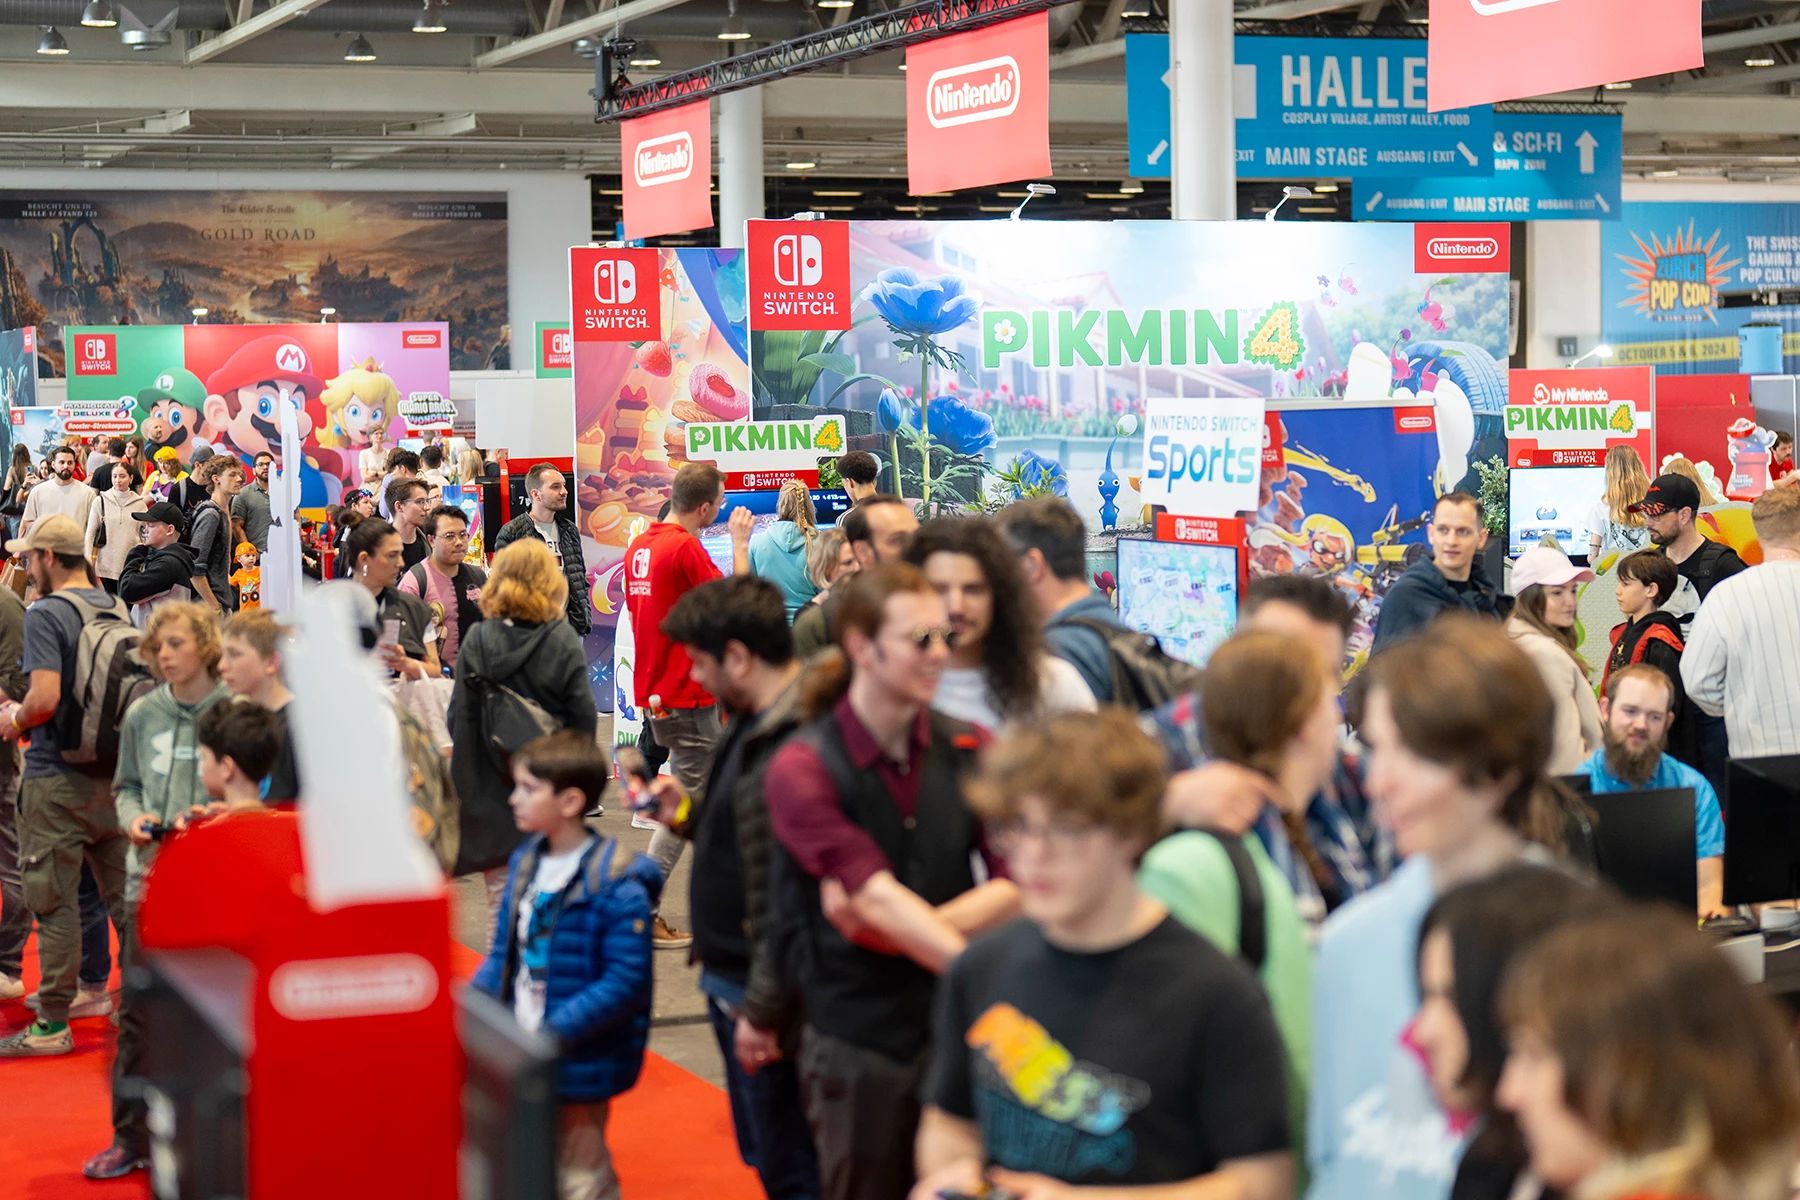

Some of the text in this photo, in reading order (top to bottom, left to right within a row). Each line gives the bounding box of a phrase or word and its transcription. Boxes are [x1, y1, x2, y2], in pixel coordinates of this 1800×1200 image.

[1282, 55, 1426, 109] HALLE
[934, 72, 1013, 114] Nintendo
[1282, 112, 1470, 126] COSPLAY VILLAGE, ARTIST ALLEY, FOOD
[1493, 131, 1562, 153] & SCI-FI
[640, 144, 688, 176] Nintendo
[1265, 147, 1310, 165] MAIN
[1315, 148, 1368, 166] STAGE
[1376, 151, 1425, 163] AUSGANG
[1432, 152, 1455, 164] EXIT
[222, 205, 236, 213] The
[1386, 199, 1424, 209] AUSGANG
[1453, 197, 1485, 211] MAIN
[1488, 197, 1530, 212] STAGE
[200, 228, 316, 243] GOLD ROAD
[1746, 236, 1767, 250] THE
[1433, 243, 1493, 254] Nintendo
[1748, 252, 1792, 267] GAMING
[1740, 267, 1762, 283] POP
[764, 292, 834, 300] NINTENDO
[1651, 280, 1710, 310] POP CON
[764, 302, 834, 315] SWITCH
[585, 317, 646, 329] SWITCH
[982, 303, 1302, 369] PIKMIN 4
[1618, 348, 1665, 361] OCTOBER
[1702, 343, 1727, 356] 2024
[1551, 387, 1608, 404] My Nintendo
[402, 402, 428, 414] MARIO
[408, 414, 450, 425] WONDER
[1150, 415, 1258, 432] NINTENDO SWITCH
[1507, 404, 1634, 433] PIKMIN 4
[689, 420, 843, 453] PIKMIN 4
[1148, 435, 1256, 493] Sports
[756, 478, 794, 487] SWITC
[1186, 528, 1219, 541] SWITCH
